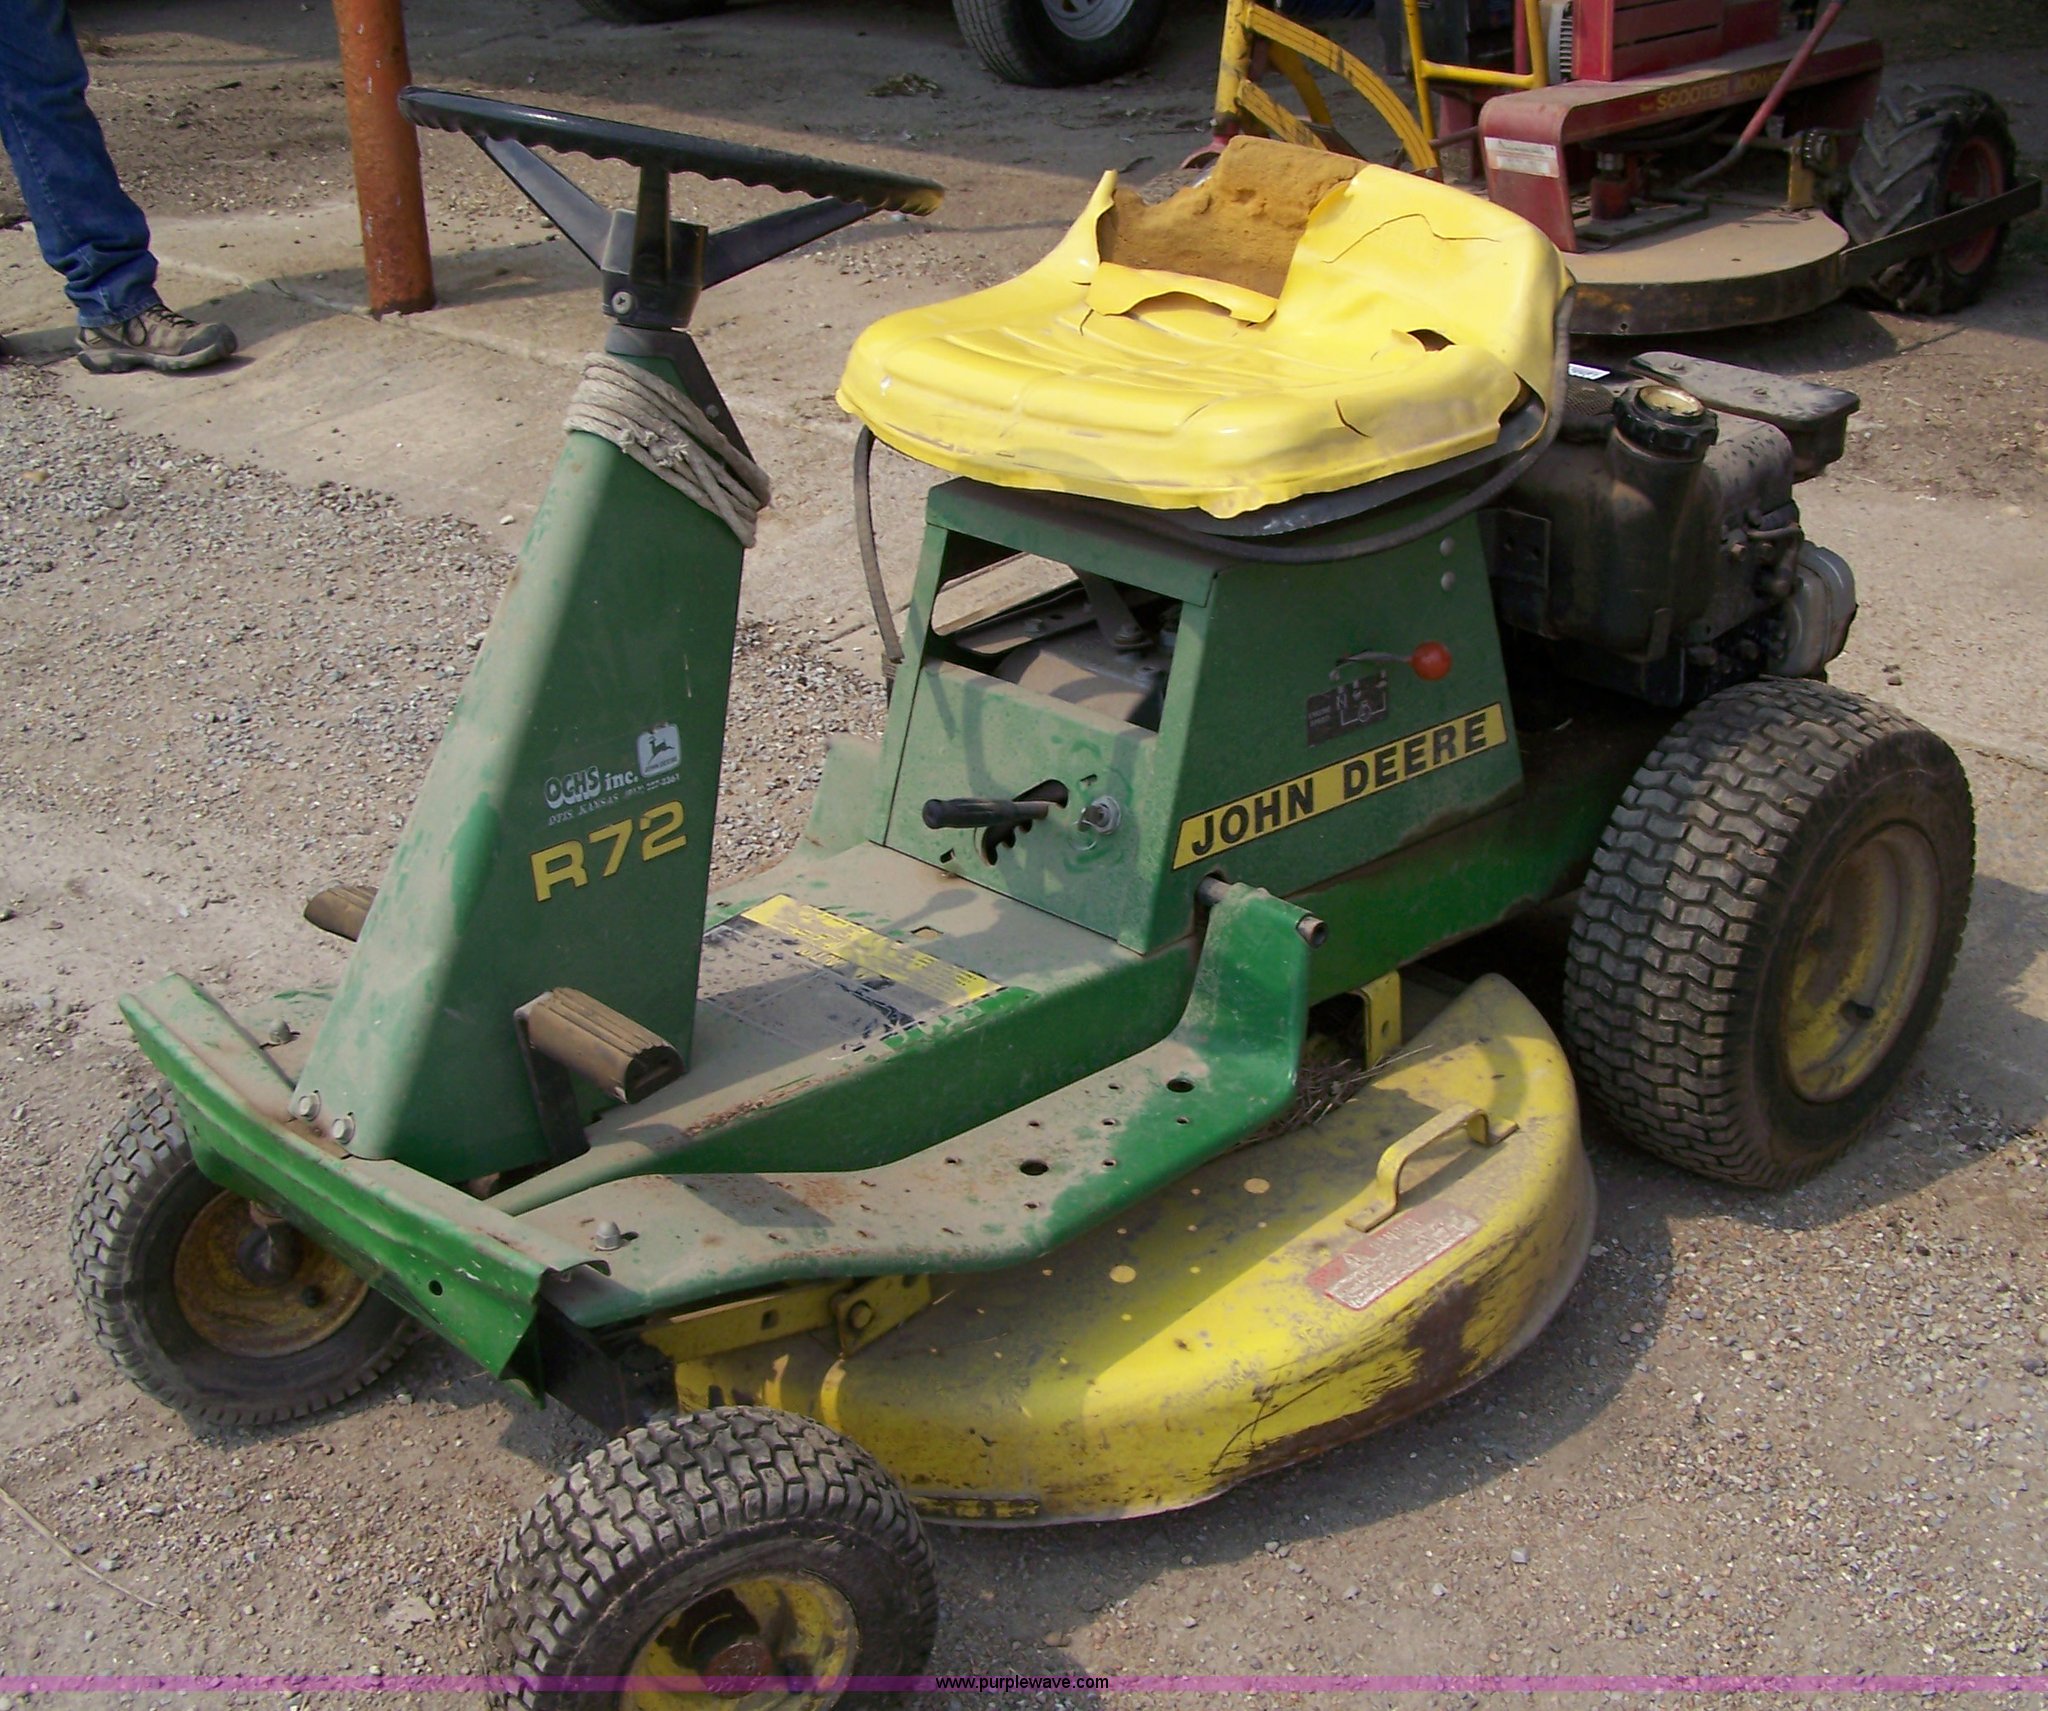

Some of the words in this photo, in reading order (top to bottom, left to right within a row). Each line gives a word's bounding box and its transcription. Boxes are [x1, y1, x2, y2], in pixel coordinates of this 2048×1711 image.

[1656, 81, 1728, 112] SCOOTER
[1191, 778, 1314, 855] JOHN
[1343, 712, 1487, 800] DEERE
[530, 800, 687, 903] R72
